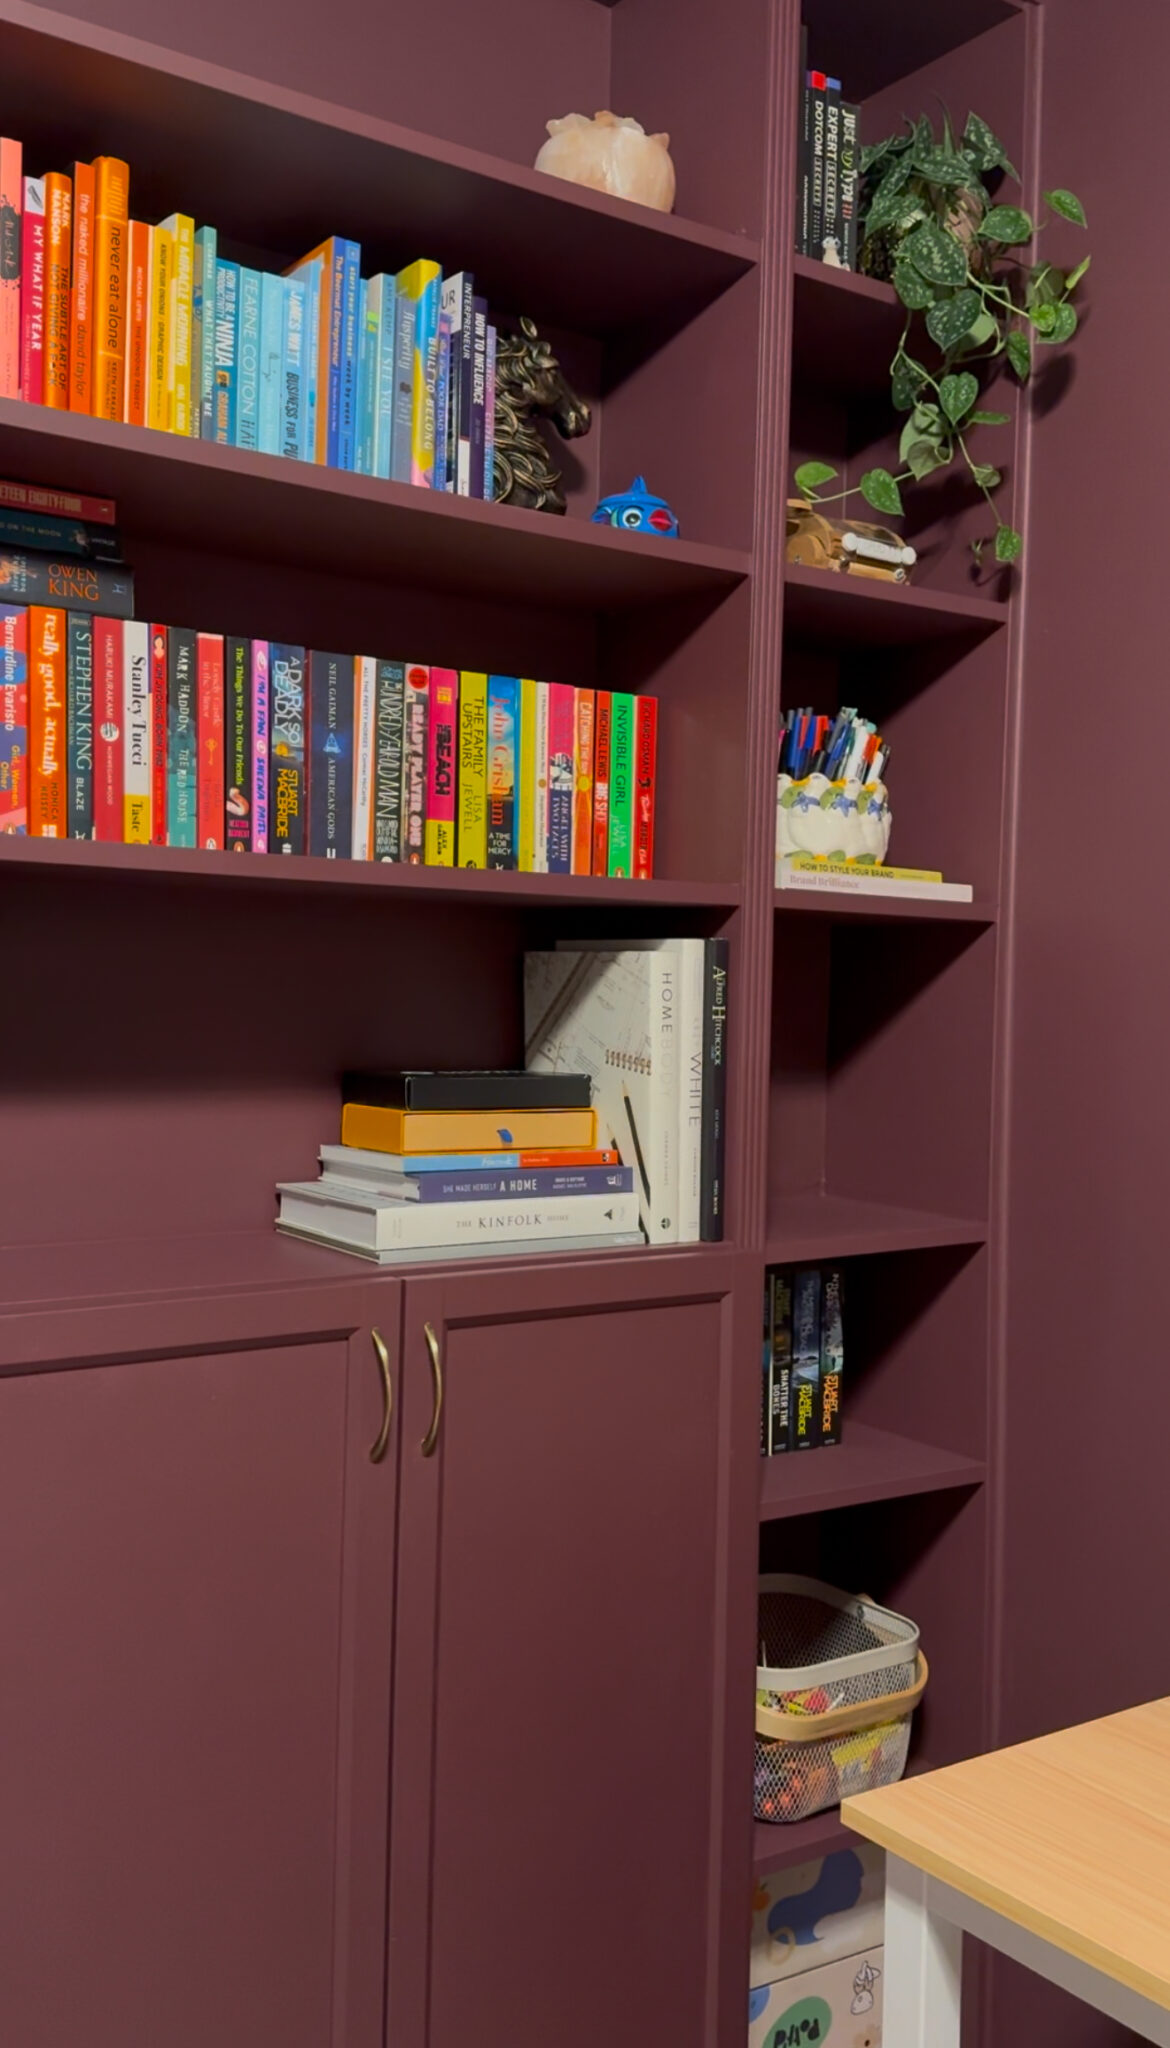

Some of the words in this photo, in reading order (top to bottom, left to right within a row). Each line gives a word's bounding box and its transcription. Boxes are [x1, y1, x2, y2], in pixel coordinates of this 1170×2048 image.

[814, 101, 824, 157] DOTCOM
[827, 106, 839, 160] EXPERT
[813, 159, 821, 206] SECRETS
[825, 162, 837, 217] SECRETS
[51, 188, 62, 246] MANSON
[62, 191, 71, 228] MARK
[79, 193, 91, 214] the
[33, 223, 43, 247] MY
[77, 217, 91, 255] naked
[110, 226, 123, 269] never
[32, 250, 43, 291] WHAT
[60, 267, 70, 292] THE
[108, 274, 121, 298] eat
[178, 245, 191, 300] MIRACLE
[347, 265, 356, 288] start
[31, 294, 42, 309] IF
[77, 258, 90, 321] millionaire
[242, 277, 258, 338] FEARNE
[345, 291, 355, 313] your
[59, 294, 69, 339] SUBTLE
[107, 304, 122, 349] alone
[206, 299, 214, 329] WHAT
[288, 291, 303, 330] JAMES
[462, 282, 472, 360] INTERPRENEUR
[475, 312, 486, 338] HOW
[31, 313, 42, 351] YEAR
[76, 325, 88, 358] david
[176, 302, 189, 367] MORNING
[205, 332, 213, 356] THEY
[214, 319, 234, 366] NINJA
[286, 332, 302, 367] WATT
[346, 315, 356, 357] business
[474, 339, 485, 351] TO
[58, 342, 68, 370] ART
[345, 361, 354, 384] week
[426, 337, 440, 375] BUILT
[58, 373, 67, 391] OF
[74, 362, 87, 396] taylor
[204, 360, 213, 400] TAUGHT
[240, 344, 256, 415] COTTON
[344, 388, 353, 399] by
[425, 378, 436, 394] TO
[473, 353, 485, 406] INFLUENCE
[203, 402, 212, 417] ME
[343, 402, 352, 425] week
[422, 399, 435, 450] BELONG
[484, 411, 493, 468] ELIZABETH
[48, 562, 98, 583] OWEN
[48, 578, 101, 603] KING
[4, 615, 18, 680] Bernardine
[38, 613, 60, 658] really
[105, 635, 114, 667] HARUKI
[175, 646, 191, 681] MARK
[235, 647, 245, 663] The
[290, 656, 301, 668] A
[38, 662, 62, 712] good,
[76, 631, 93, 716] STEPHEN
[127, 655, 148, 716] Stanley
[233, 666, 245, 694] Things
[327, 662, 338, 687] NEIL
[4, 684, 17, 732] Evaristo
[104, 670, 114, 718] MURAKAMI
[176, 685, 192, 734] HADDON
[235, 696, 244, 709] We
[257, 697, 266, 707] A
[274, 660, 290, 735] DEADLY
[287, 668, 303, 720] DARK
[327, 688, 338, 729] GAIMAN
[361, 695, 369, 719] PRETTY
[472, 697, 484, 725] THE
[235, 711, 244, 722] Do
[235, 724, 244, 735] To
[256, 710, 266, 736] FAN
[287, 722, 301, 745] SO
[361, 721, 369, 748] HORSES
[410, 703, 425, 754] READY
[489, 695, 511, 740] John
[598, 708, 609, 747] MICHAEL
[642, 701, 653, 739] RICHARD
[38, 716, 60, 777] actually
[75, 721, 92, 771] KING
[132, 721, 148, 766] Tucci
[235, 738, 244, 752] Our
[461, 702, 474, 769] UPSTAIRS
[473, 729, 484, 778] FAMILY
[615, 704, 629, 769] INVISIBLE
[0, 760, 10, 790] Other
[178, 749, 190, 767] THE
[235, 754, 245, 785] Friends
[436, 732, 452, 796] BEACH
[597, 750, 608, 778] LEWIS
[641, 741, 651, 775] OSMAN
[75, 777, 85, 811] BLAZE
[106, 786, 114, 805] WOOD
[176, 769, 188, 789] RED
[287, 769, 299, 817] STUART
[326, 756, 338, 809] AMERICAN
[408, 756, 423, 811] PLAYER
[490, 745, 511, 826] Grisham
[614, 774, 626, 807] GIRL
[50, 782, 60, 820] MONICA
[130, 801, 143, 832] Taste
[176, 791, 189, 824] HOUSE
[275, 768, 289, 838] MACBRIDE
[462, 783, 473, 833] JEWELL
[472, 794, 482, 823] LISA
[552, 796, 561, 821] TWO
[560, 795, 569, 831] ANGEL
[324, 811, 337, 840] GODS
[408, 814, 422, 847] ONE
[551, 825, 560, 859] FACES
[610, 814, 620, 855] JEWELL
[619, 824, 628, 848] LISA
[559, 834, 569, 862] WITH
[800, 862, 818, 872] HOW
[819, 864, 828, 872] TO
[830, 865, 850, 875] STYLE
[851, 867, 870, 877] YOUR
[872, 869, 895, 879] BRAND
[712, 1005, 727, 1066] HITCHCOCK
[688, 1051, 703, 1127] WHITE
[442, 1184, 454, 1193] SHE
[455, 1183, 471, 1192] MADE
[472, 1182, 497, 1191] HERSELF
[499, 1181, 506, 1192] A
[510, 1179, 537, 1191] HOME
[456, 1220, 472, 1228] THE
[478, 1213, 542, 1229] KINFOLK
[779, 1368, 789, 1407] SHATTER
[804, 1383, 813, 1418] STUART
[822, 1374, 833, 1432] MACBRIDE
[830, 1374, 839, 1413] STUART
[779, 1409, 788, 1426] THE
[797, 1384, 807, 1435] MACBRIDE
